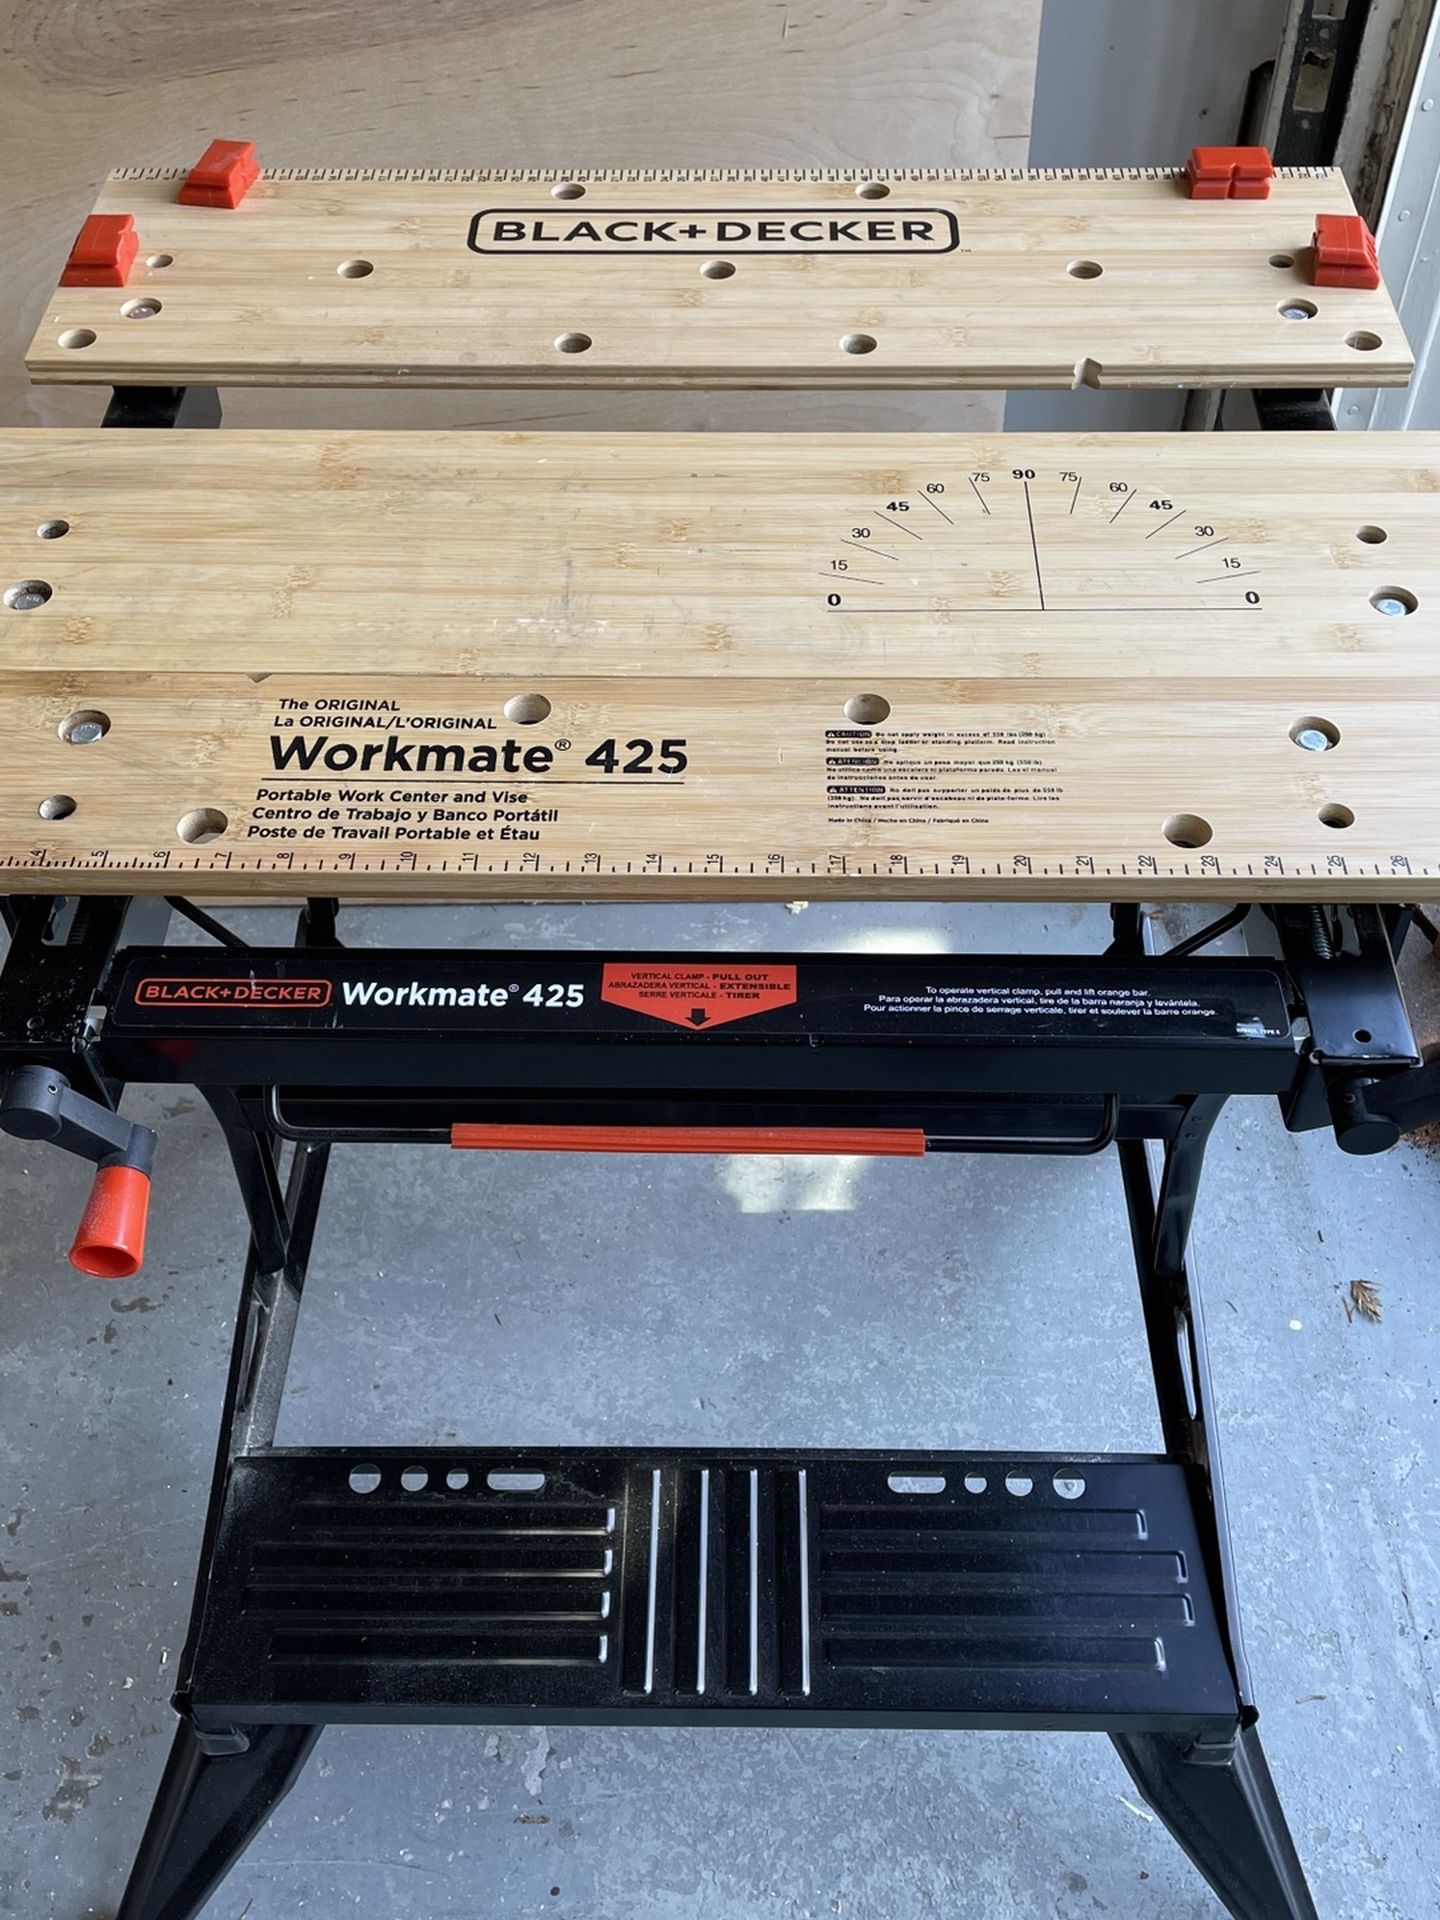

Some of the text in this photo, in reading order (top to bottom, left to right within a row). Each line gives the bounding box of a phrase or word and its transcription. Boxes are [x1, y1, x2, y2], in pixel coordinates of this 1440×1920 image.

[492, 221, 935, 242] BLACK+DECKER
[972, 472, 991, 482] 75
[1012, 469, 1036, 480] 90
[1060, 472, 1078, 482] 75
[926, 483, 945, 493] 60
[1109, 483, 1128, 493] 60
[886, 501, 910, 512] 45
[1149, 500, 1174, 510] 45
[851, 528, 871, 538] 30
[1195, 527, 1214, 537] 30
[830, 560, 848, 570] 15
[1222, 558, 1241, 568] 15
[827, 594, 841, 606] 0
[1245, 591, 1260, 604] 0
[279, 698, 401, 712] The ORIGINAL
[274, 715, 497, 729] La ORIGINAL/L'ORIGINAL
[585, 739, 688, 774] 425
[256, 788, 528, 804] Portable Work Center and Vise
[252, 807, 559, 823] Centro de Trabajo y Banco Portátil
[248, 825, 540, 841] Poste de Travail Portable et Étau
[400, 851, 413, 863] 10
[462, 853, 475, 863] 11
[523, 852, 536, 864] 12
[585, 853, 597, 864] 13
[646, 854, 659, 864] 14
[707, 854, 719, 864] 15
[768, 854, 780, 864] 16
[830, 854, 841, 864] 17
[891, 854, 903, 865] 18
[952, 855, 965, 865] 19
[1014, 855, 1027, 866] 20
[1076, 856, 1089, 866] 21
[1138, 855, 1152, 867] 22
[1201, 856, 1215, 866] 23
[1265, 856, 1279, 867] 24
[145, 986, 321, 1000] BLACK+DECKER
[522, 984, 584, 1008] 425
[926, 986, 938, 994] To
[939, 987, 974, 995] operate
[977, 987, 1010, 995] vertical
[1045, 988, 1062, 996] pull
[1097, 989, 1130, 997] orange
[878, 995, 900, 1003] Para
[903, 996, 933, 1004] operar
[946, 996, 999, 1004] abrazadera
[1109, 999, 1145, 1007] naranja
[864, 1004, 886, 1012] Pour
[888, 1004, 931, 1012] actionner
[944, 1005, 970, 1013] pince
[972, 1005, 984, 1013] de
[986, 1006, 1022, 1014] serrage
[1154, 1008, 1179, 1016] barre
